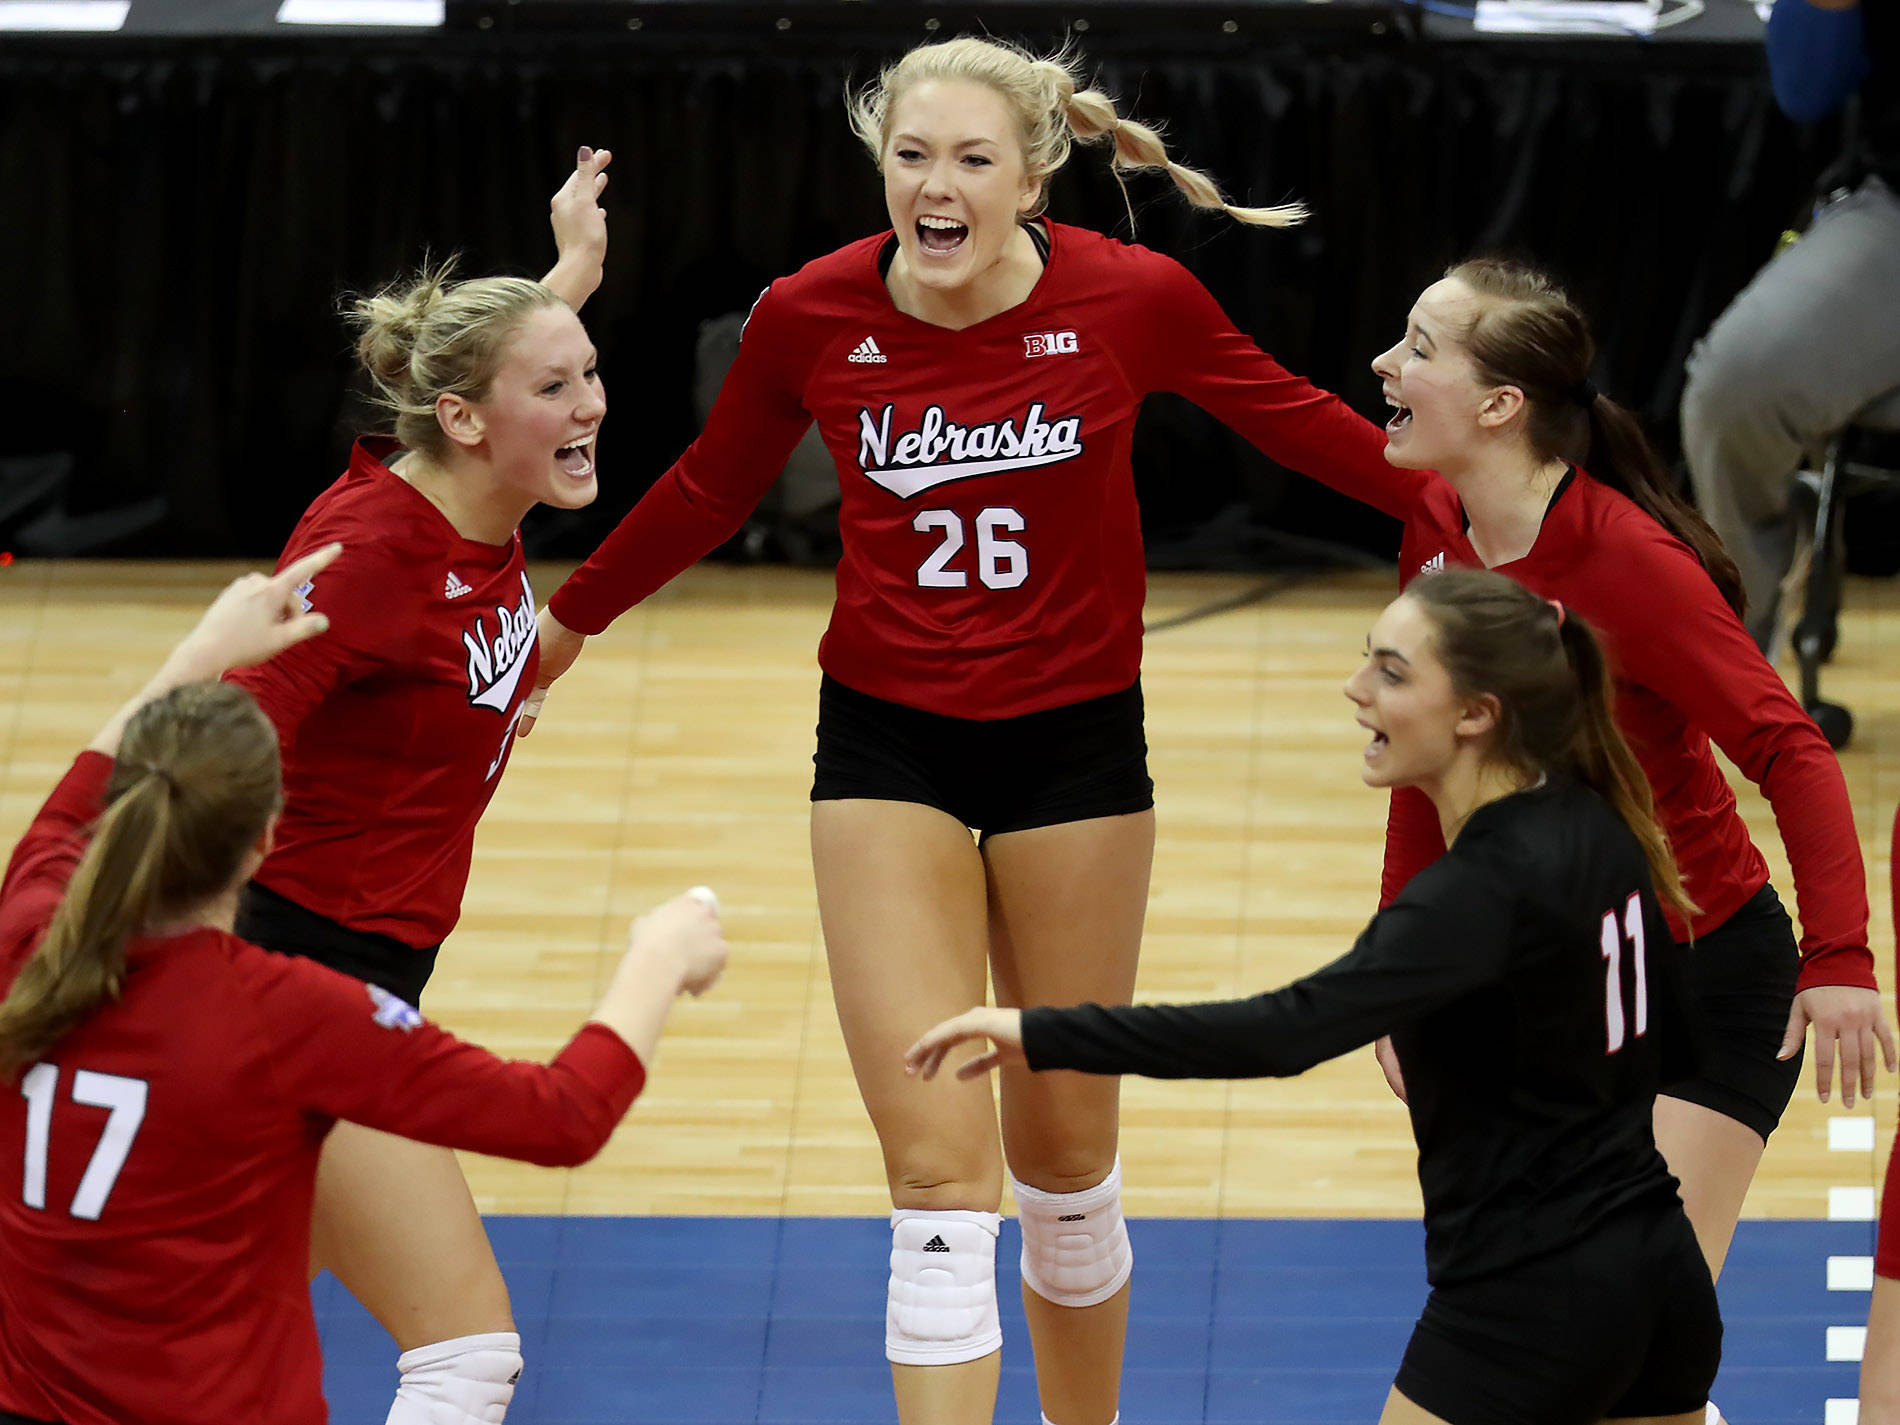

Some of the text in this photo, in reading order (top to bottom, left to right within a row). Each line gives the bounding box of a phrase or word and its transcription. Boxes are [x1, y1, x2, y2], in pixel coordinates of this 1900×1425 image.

[848, 353, 887, 363] adidas
[857, 401, 1084, 470] Nebraska
[912, 507, 1029, 590] 26
[1600, 889, 1648, 1056] 11
[20, 1062, 149, 1222] 17
